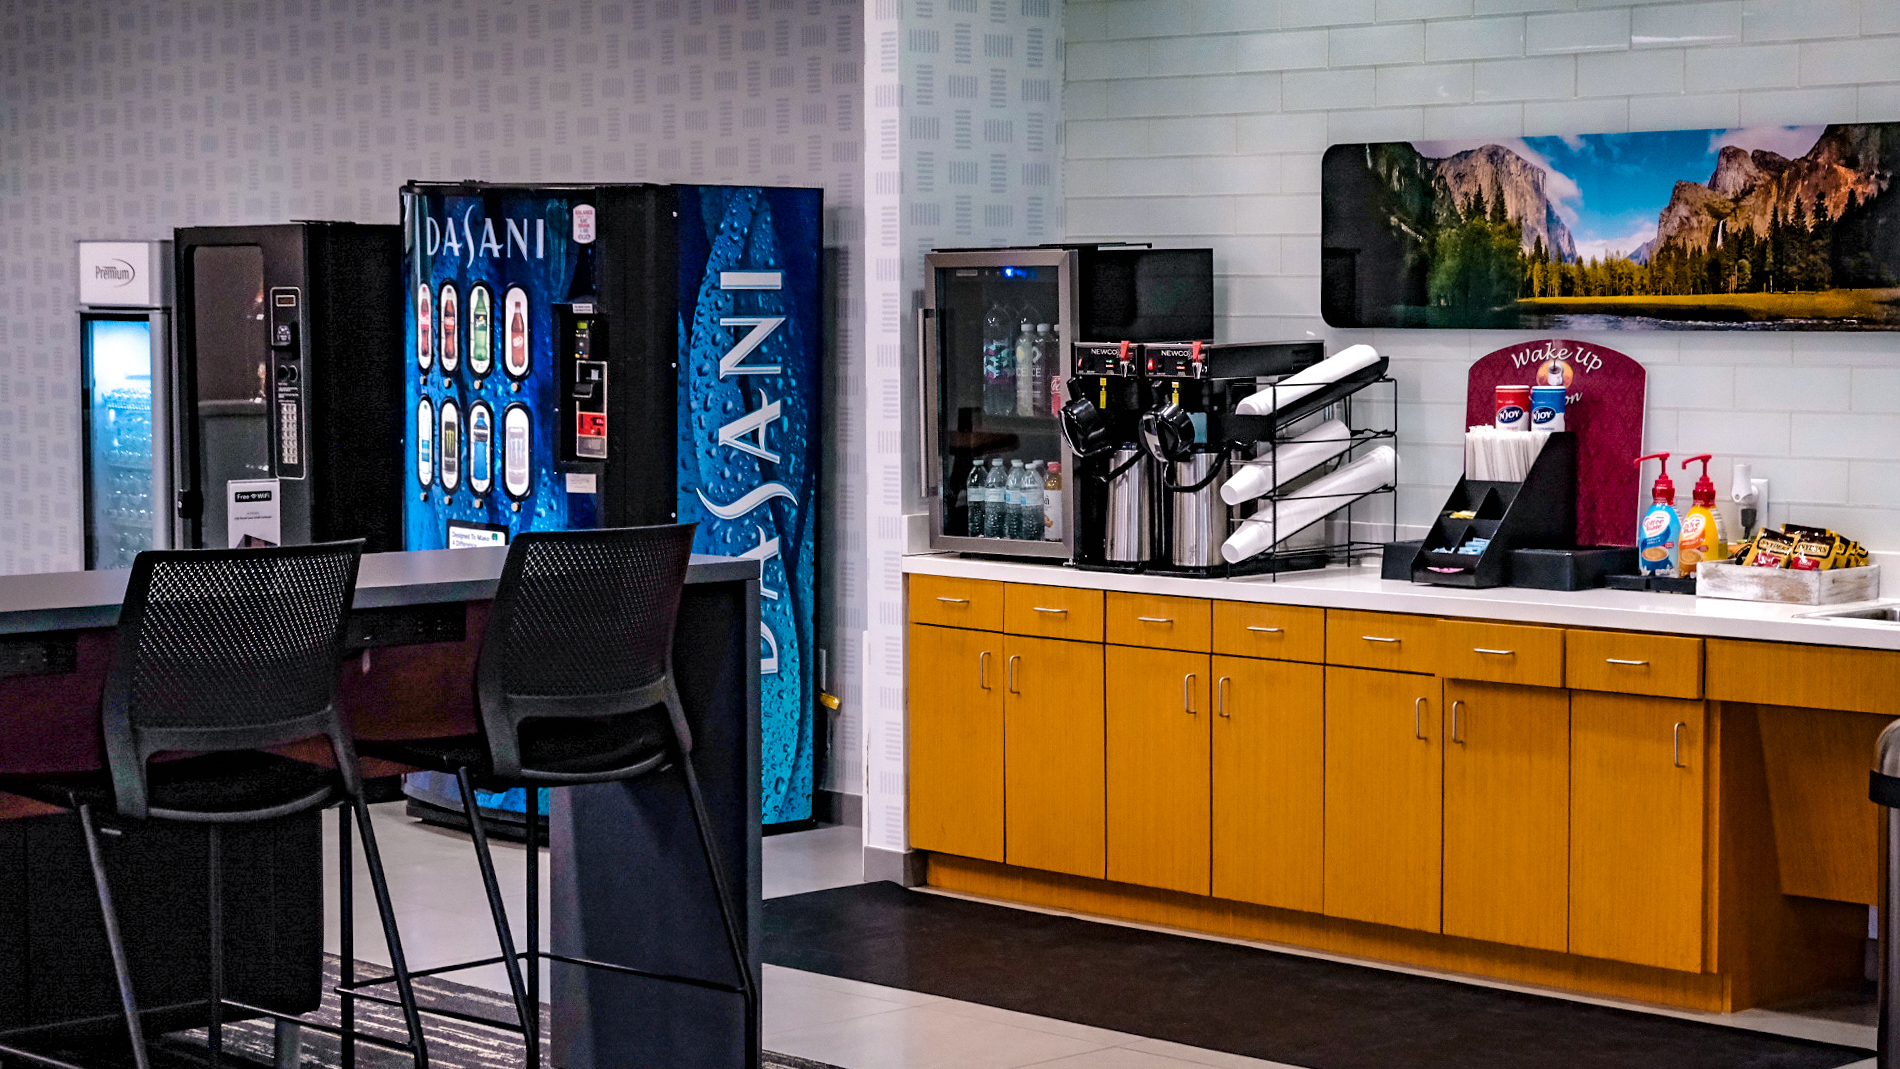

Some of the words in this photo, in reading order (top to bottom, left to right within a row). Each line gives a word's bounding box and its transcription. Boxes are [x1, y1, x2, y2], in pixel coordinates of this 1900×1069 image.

[426, 204, 544, 268] DASANI
[95, 266, 130, 280] Premium
[1511, 342, 1573, 369] Wake
[1575, 346, 1603, 373] Up
